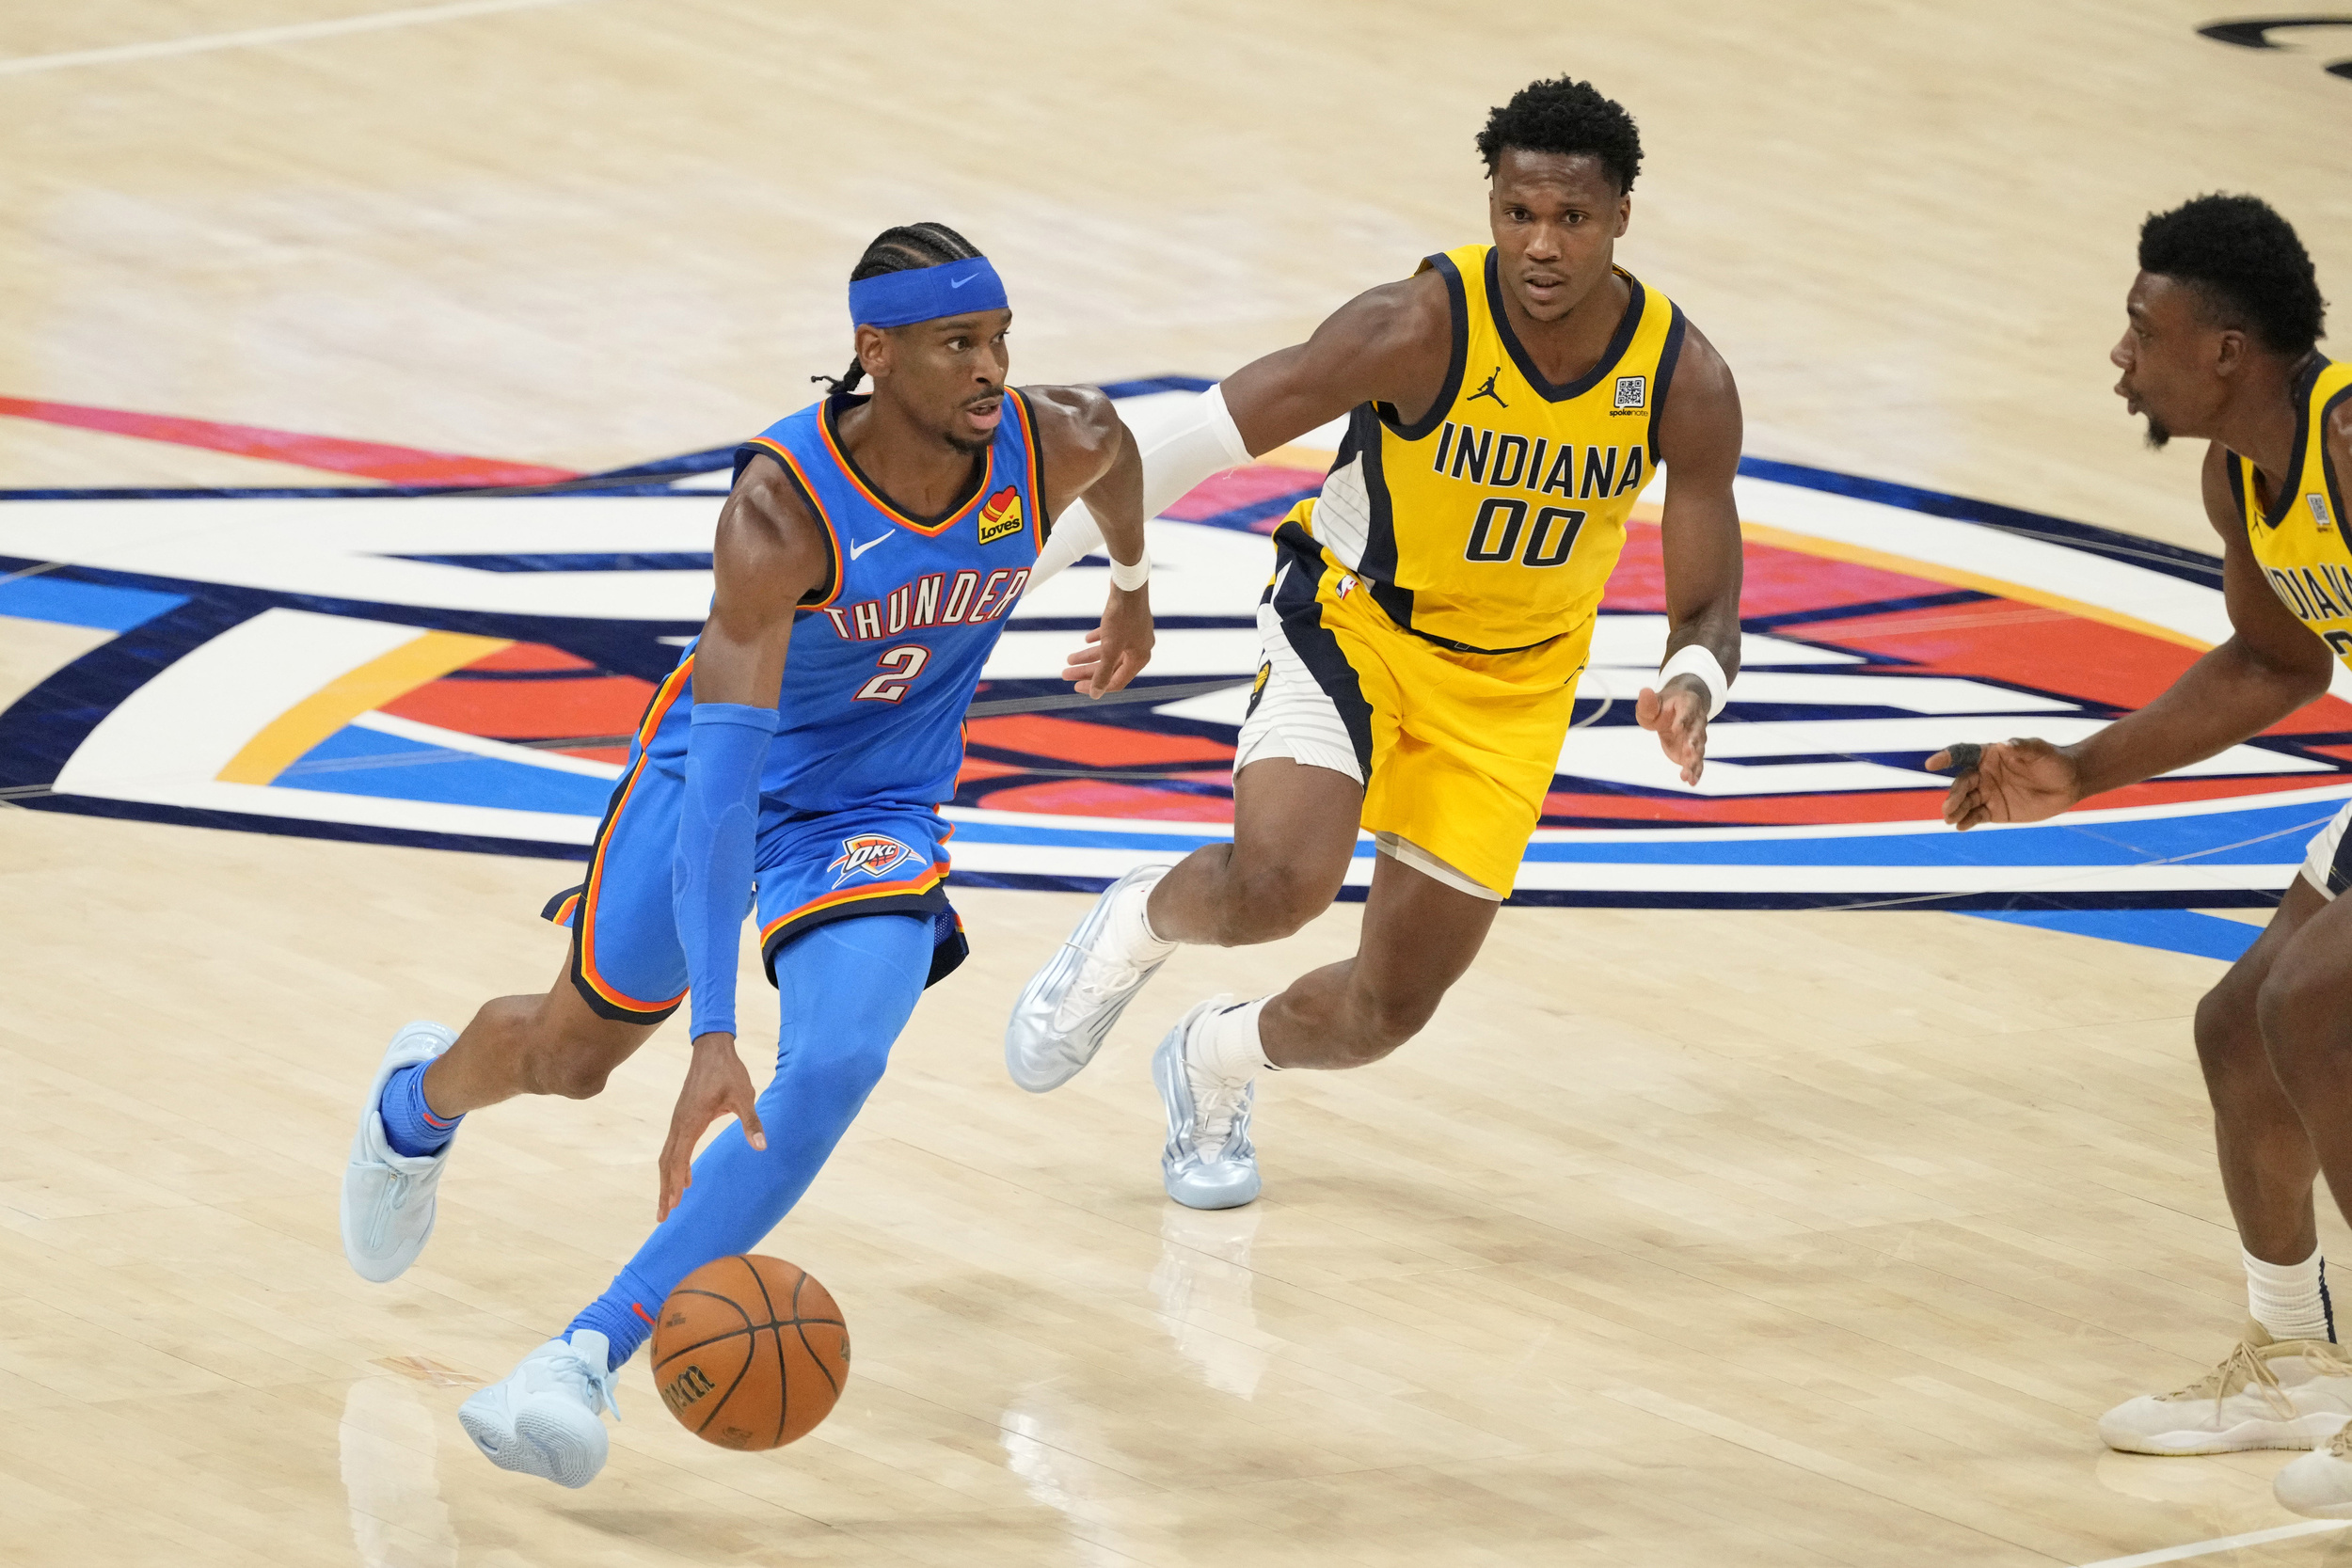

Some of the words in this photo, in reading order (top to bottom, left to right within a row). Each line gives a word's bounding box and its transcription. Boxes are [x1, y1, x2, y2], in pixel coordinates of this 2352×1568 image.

[1609, 408, 1649, 418] spokenote
[1433, 420, 1645, 500] INDIANA
[1464, 497, 1588, 568] 00
[823, 566, 1032, 641] THUNDER
[850, 643, 931, 705] 2
[843, 844, 898, 873] OKC
